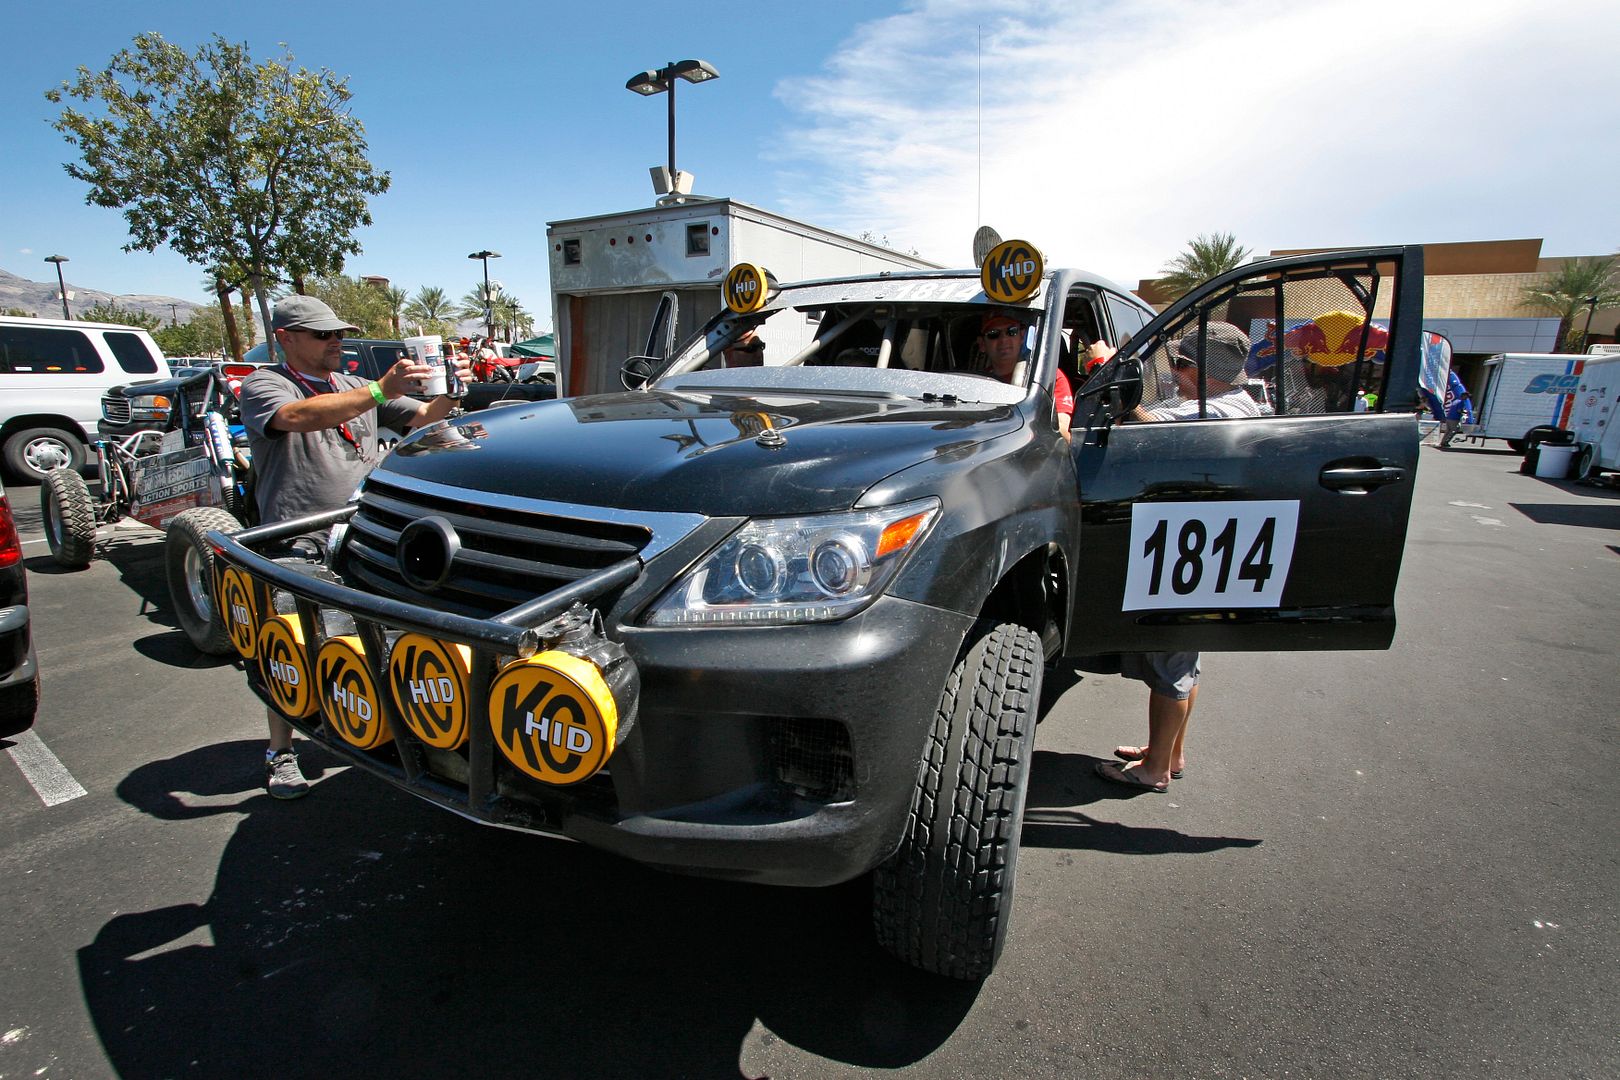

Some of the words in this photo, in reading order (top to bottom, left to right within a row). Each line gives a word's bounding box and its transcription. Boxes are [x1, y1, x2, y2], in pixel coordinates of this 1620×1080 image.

[729, 268, 755, 309] KC
[735, 280, 757, 294] HID
[988, 246, 1032, 297] KC
[1001, 260, 1036, 278] HID
[141, 488, 171, 503] ACTION
[171, 477, 208, 495] SPORTS
[1143, 517, 1276, 595] 1814
[225, 577, 250, 650] KC
[231, 604, 250, 626] HID
[259, 631, 298, 707] KC
[269, 657, 300, 686] HID
[321, 655, 368, 740] KC
[333, 681, 373, 721] HID
[392, 645, 453, 740] KC
[408, 677, 455, 704] HID
[501, 680, 587, 774] KC
[524, 710, 593, 753] HID
